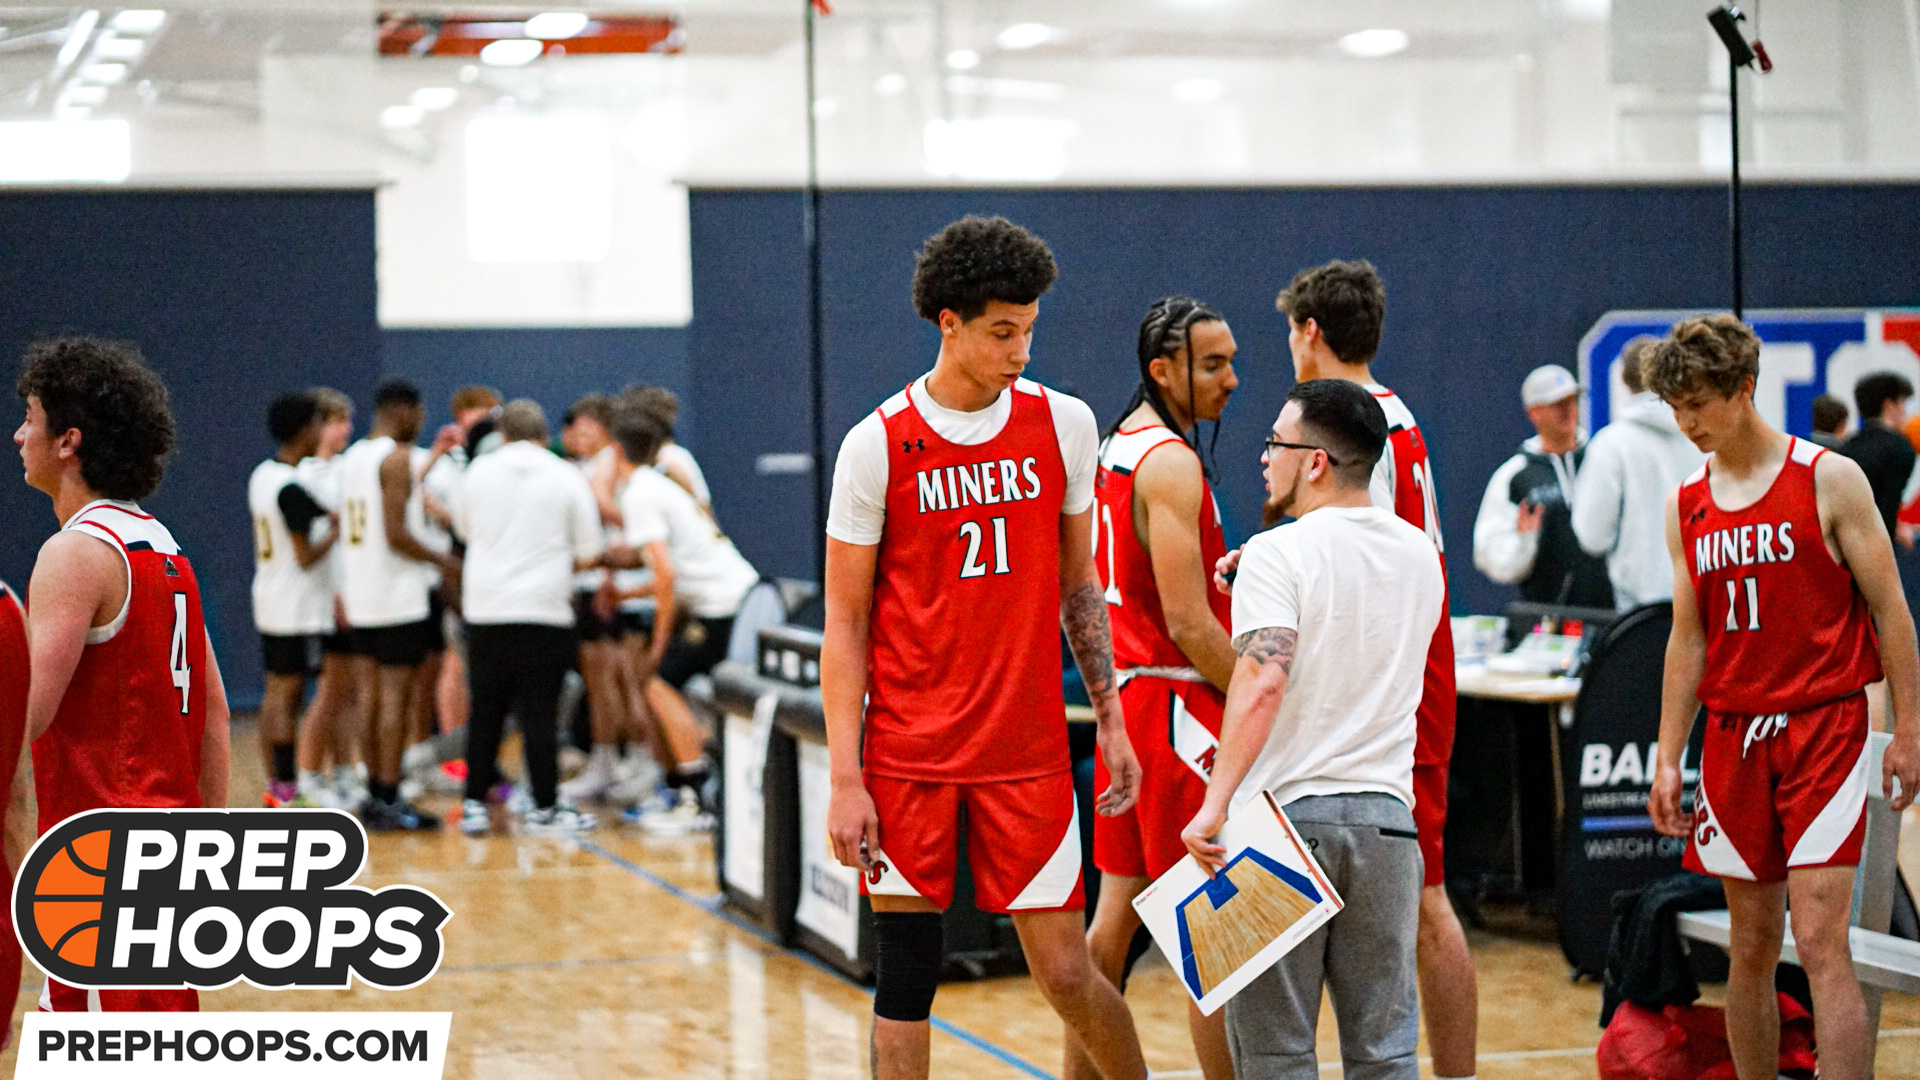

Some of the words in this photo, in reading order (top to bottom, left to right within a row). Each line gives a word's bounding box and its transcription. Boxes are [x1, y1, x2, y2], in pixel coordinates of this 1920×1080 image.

[916, 456, 1042, 514] MINERS
[959, 515, 1012, 580] 21
[1695, 521, 1796, 577] MINERS
[1724, 576, 1761, 632] 11
[169, 591, 193, 715] 4
